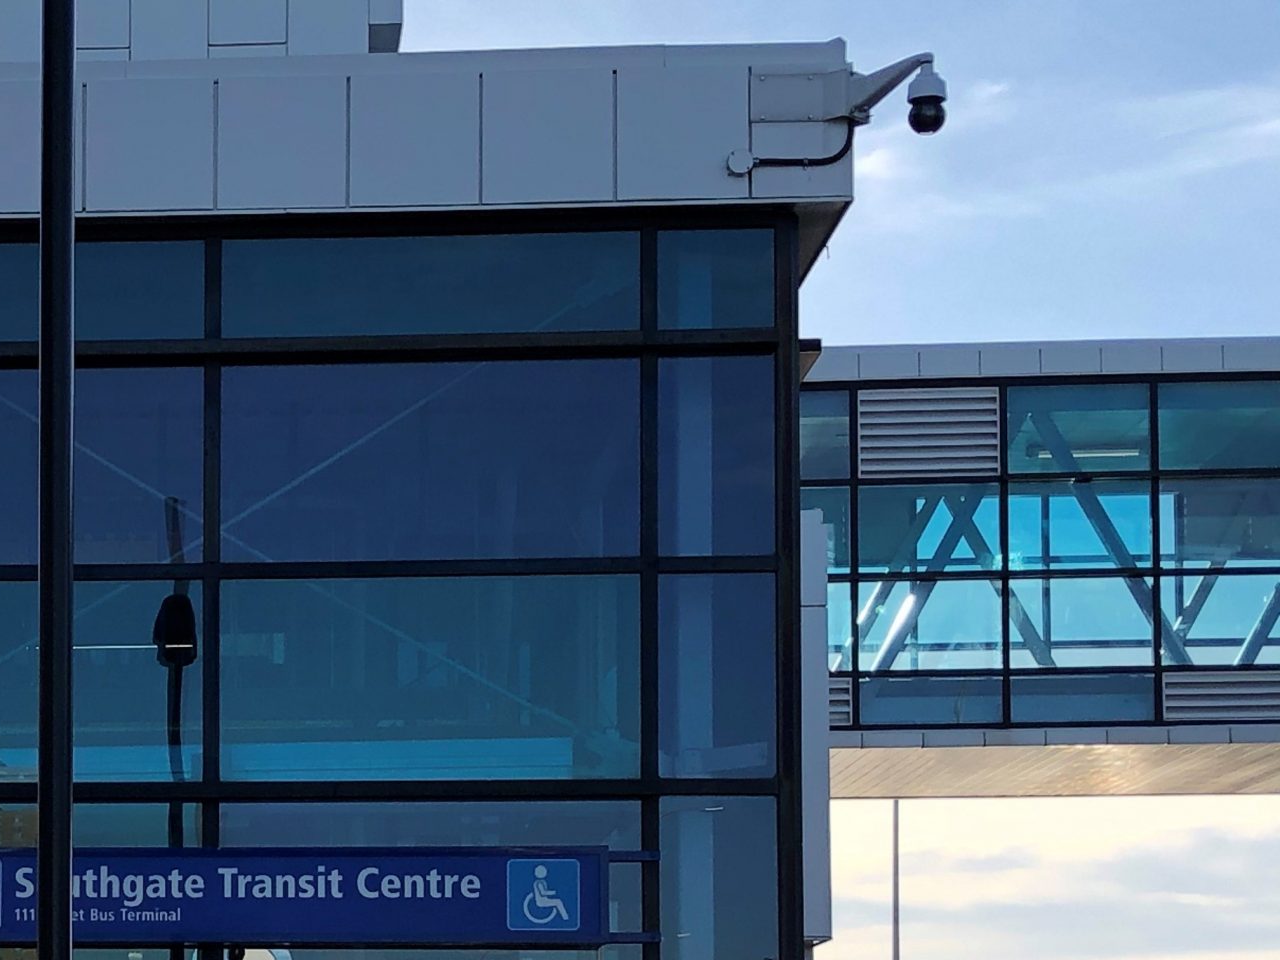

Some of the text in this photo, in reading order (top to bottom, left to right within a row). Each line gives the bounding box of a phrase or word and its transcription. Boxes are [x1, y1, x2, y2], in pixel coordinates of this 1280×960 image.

[14, 865, 481, 907] Sthgate Transit Centre
[14, 908, 36, 922] 111
[90, 908, 115, 922] Bus
[120, 908, 182, 922] Terminal
